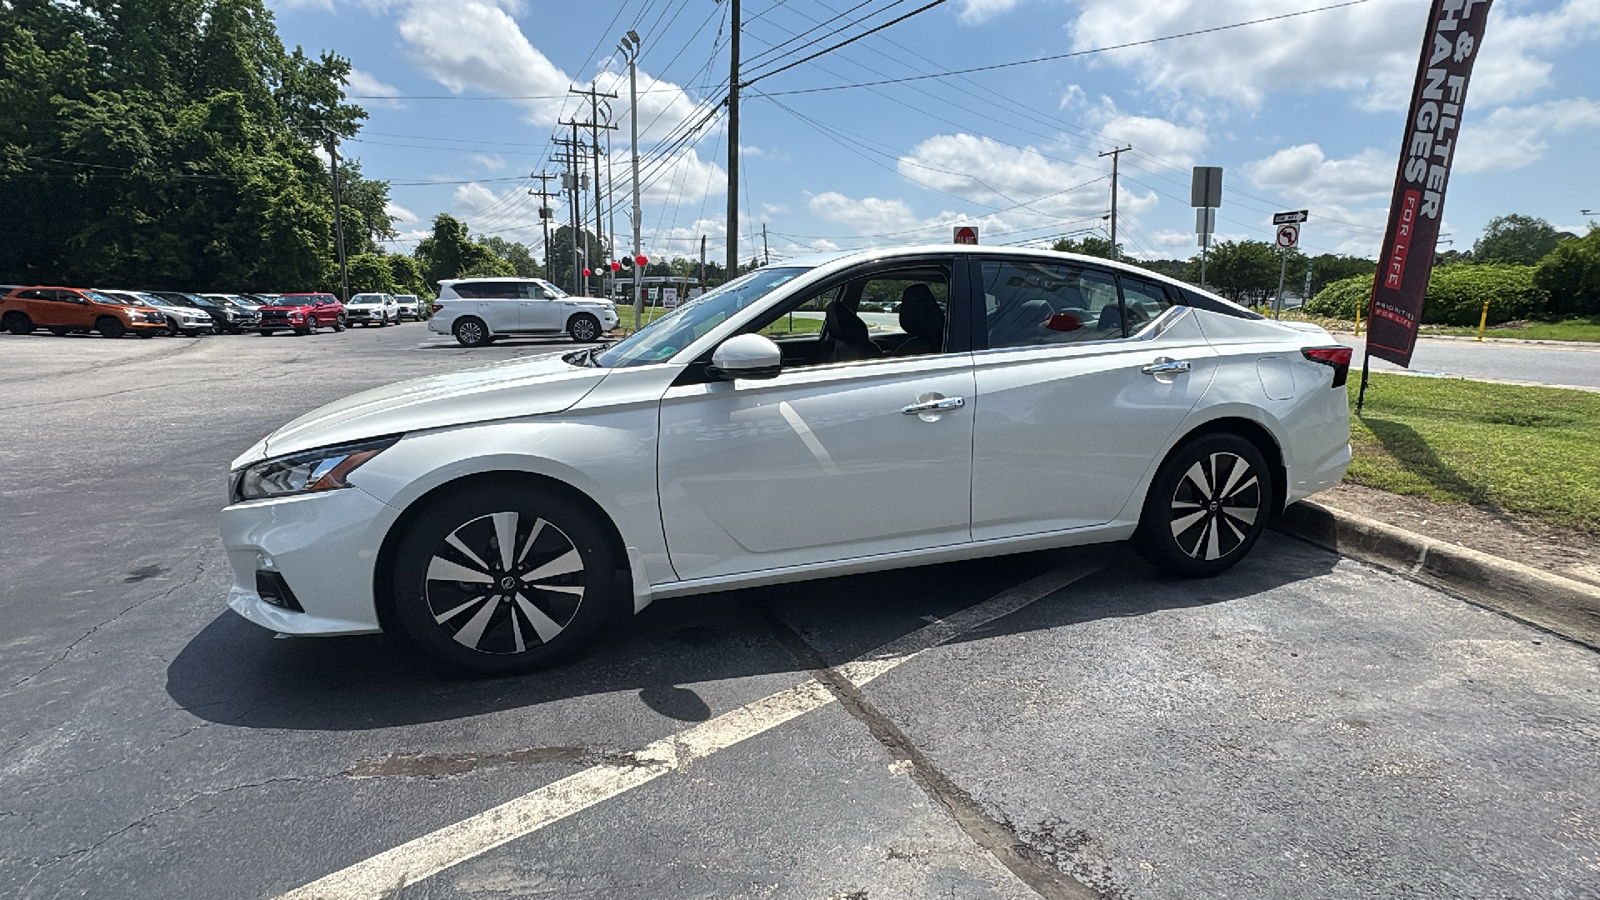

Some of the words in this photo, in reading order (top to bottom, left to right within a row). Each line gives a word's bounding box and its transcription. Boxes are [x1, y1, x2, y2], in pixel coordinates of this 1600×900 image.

[1453, 31, 1474, 63] &
[1404, 0, 1464, 184] HANGES
[1420, 75, 1466, 220] FILTER
[1399, 196, 1416, 236] FOR
[1388, 244, 1405, 286] LIFE
[1375, 301, 1414, 321] PRIORITIES
[1376, 309, 1394, 319] FOR
[1395, 316, 1411, 328] LIFE
